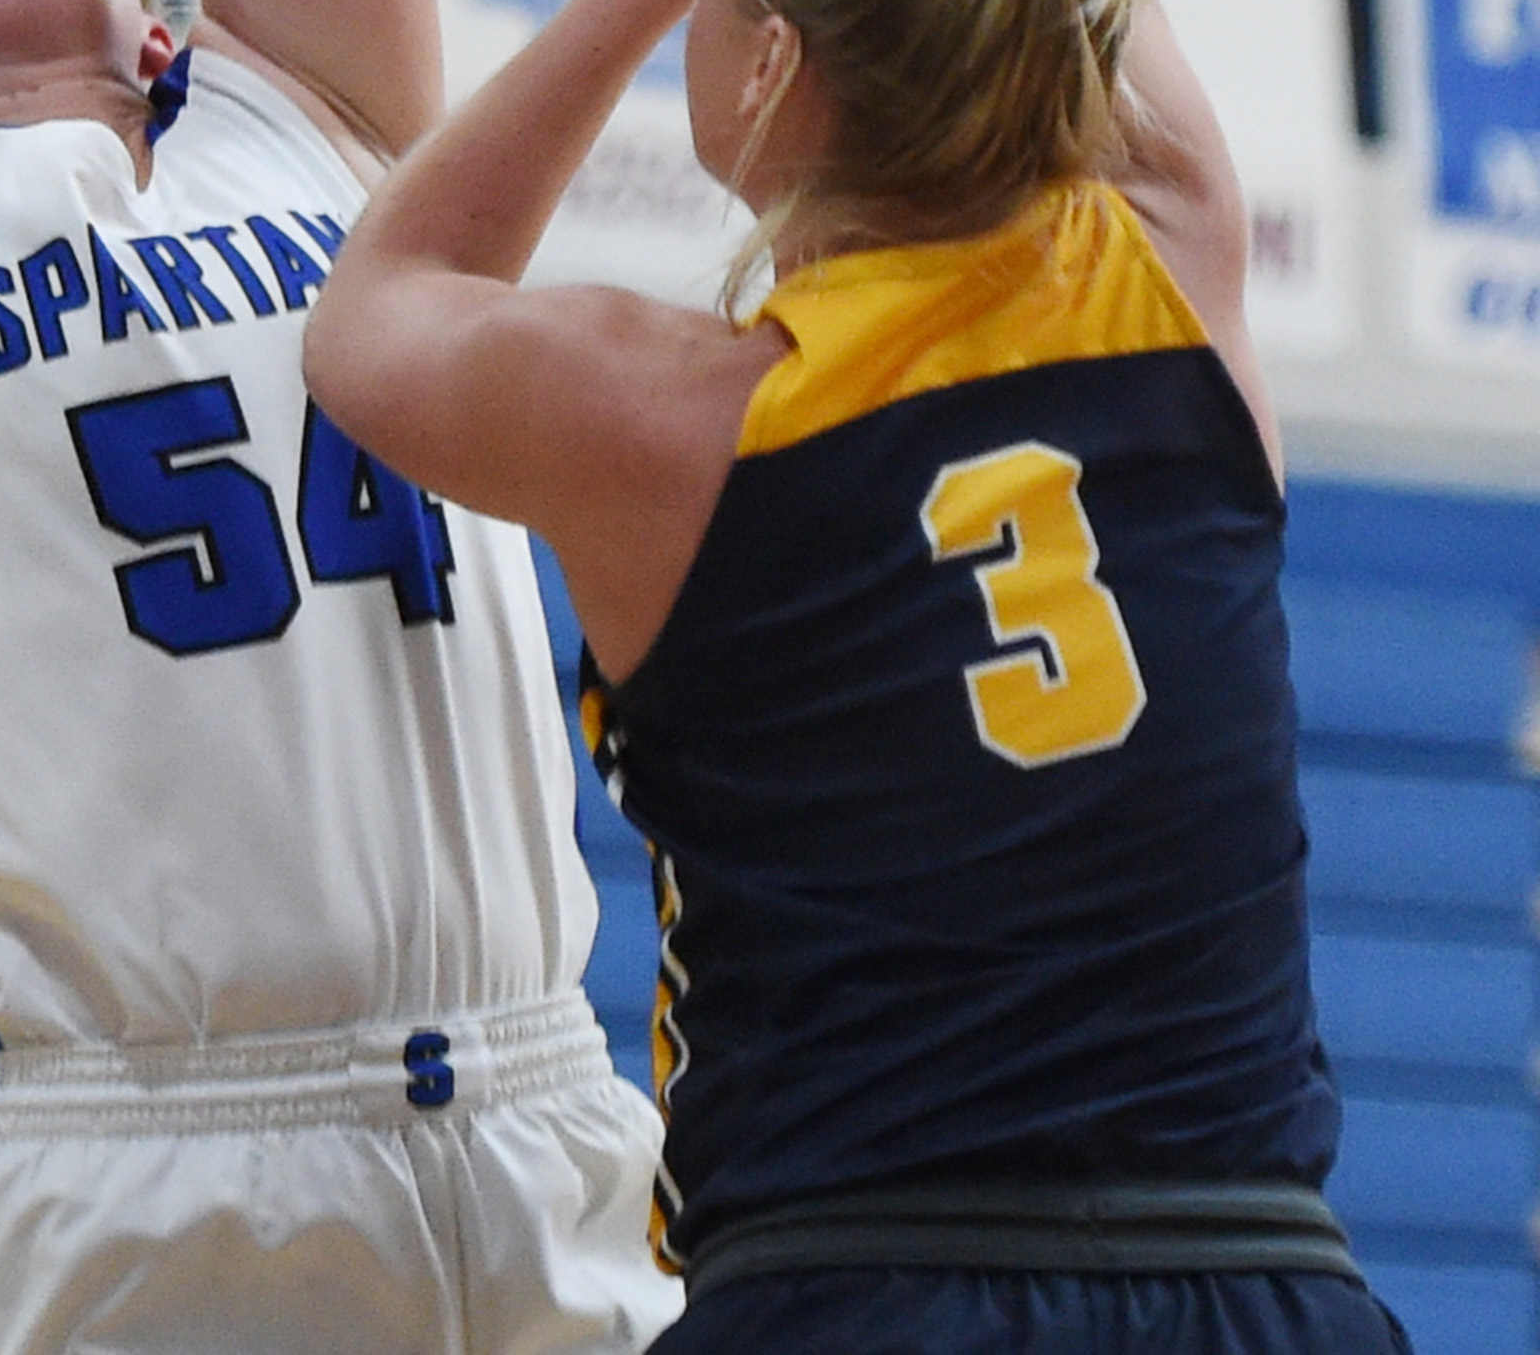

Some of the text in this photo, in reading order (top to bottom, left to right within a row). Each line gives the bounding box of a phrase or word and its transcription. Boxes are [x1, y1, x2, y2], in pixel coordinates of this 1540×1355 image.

[65, 375, 457, 657] 54
[919, 440, 1148, 769] 3
[403, 1029, 455, 1112] S
